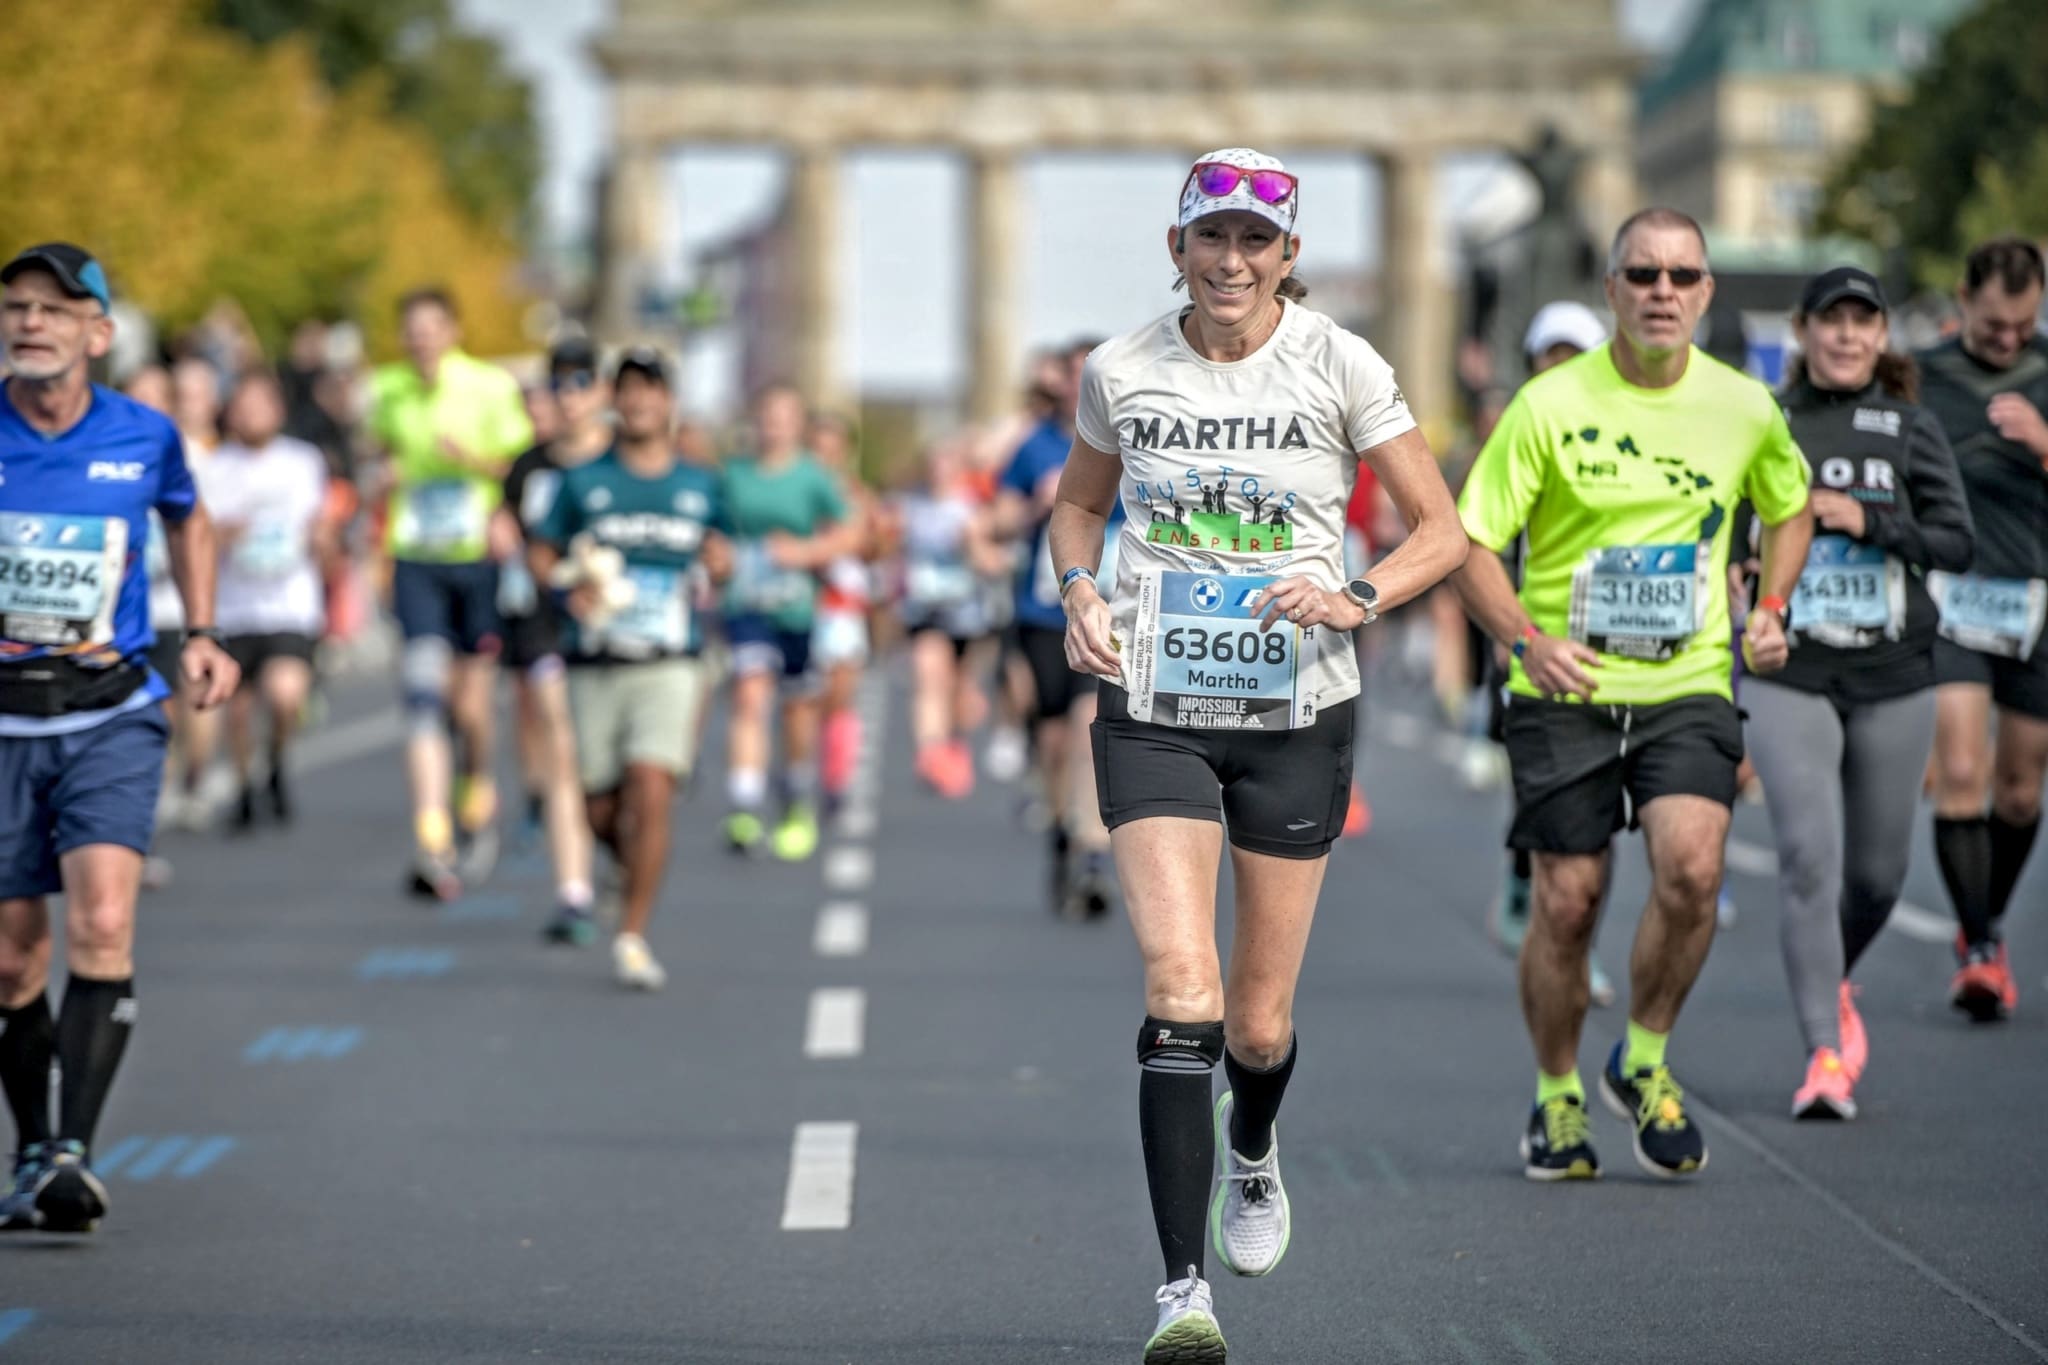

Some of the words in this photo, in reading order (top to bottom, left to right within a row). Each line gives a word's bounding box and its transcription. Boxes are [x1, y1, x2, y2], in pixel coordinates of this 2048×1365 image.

[1132, 415, 1309, 450] MARTHA
[1151, 528, 1284, 551] INSPIRE
[0, 557, 97, 590] 26994
[1600, 578, 1686, 607] 31883
[1136, 585, 1150, 669] BERLIN-ATHON
[1145, 635, 1153, 654] 2022
[1164, 627, 1286, 665] 63608
[1142, 656, 1152, 696] September
[1187, 669, 1259, 690] Martha
[1141, 697, 1149, 708] 25.
[1178, 696, 1248, 715] IMPOSSIBLE
[1176, 711, 1189, 726] IS
[1189, 712, 1242, 728] NOTHING
